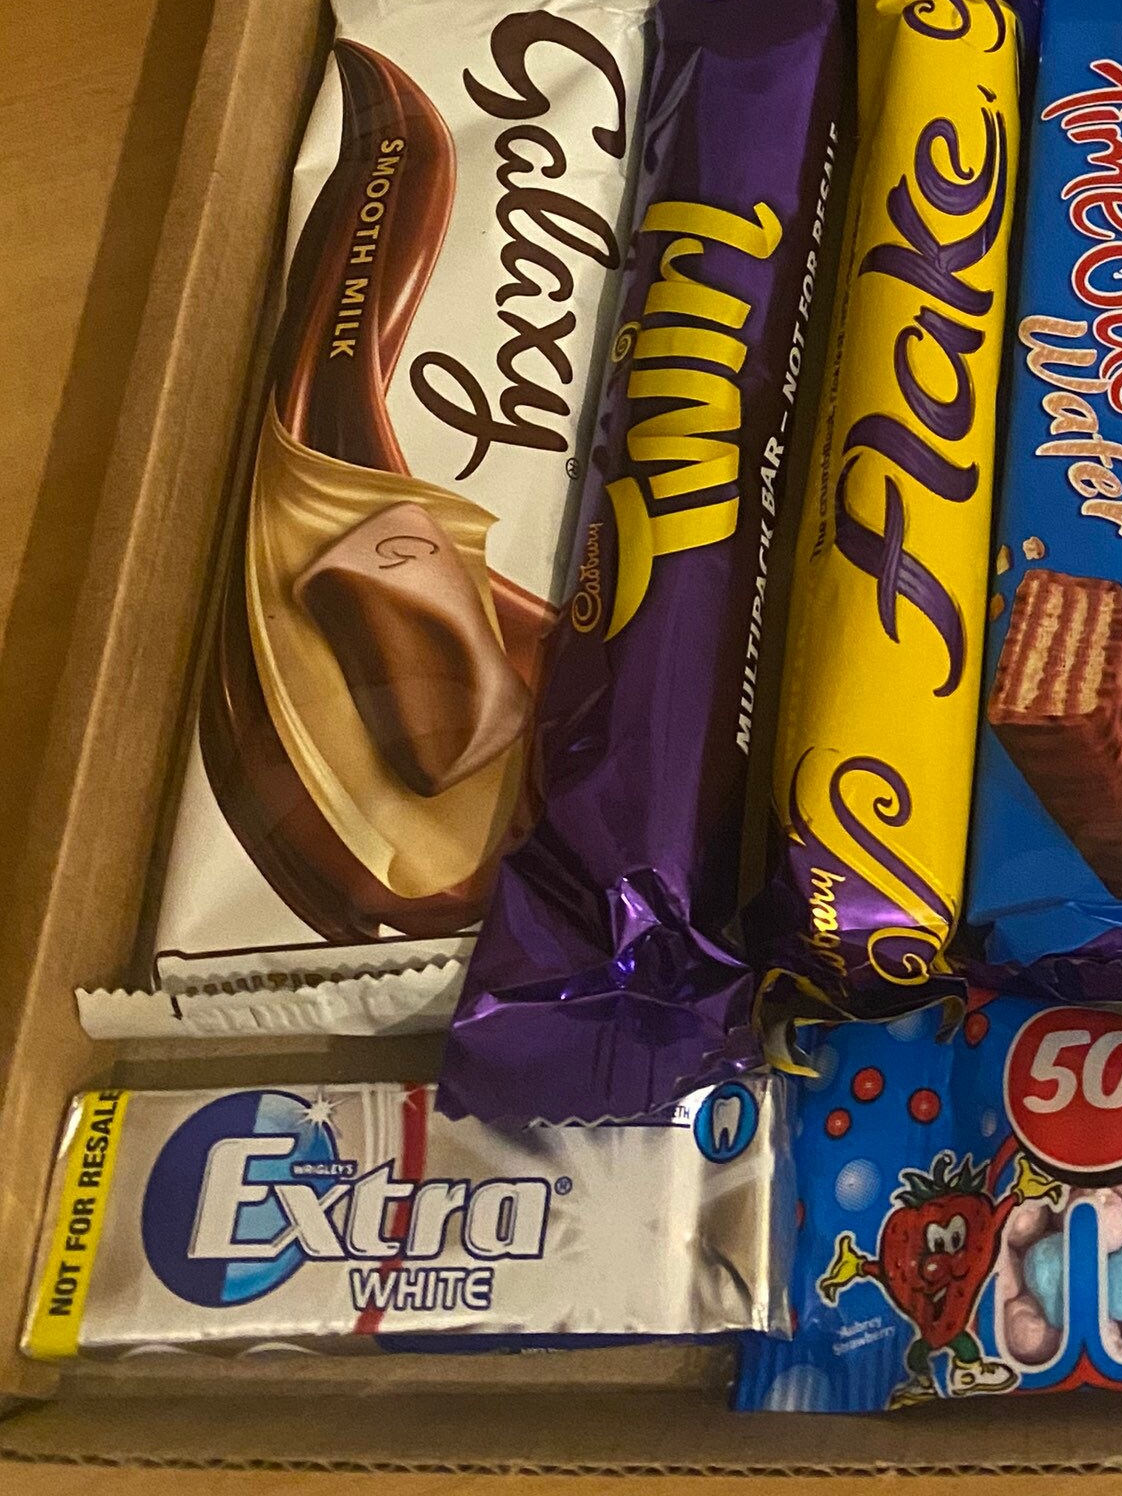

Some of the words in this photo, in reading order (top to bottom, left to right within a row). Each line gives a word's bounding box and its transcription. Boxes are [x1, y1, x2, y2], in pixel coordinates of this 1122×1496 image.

[351, 136, 406, 266] SMOOTH
[409, 9, 627, 481] Galaxy
[330, 278, 376, 361] MILK
[604, 201, 783, 643] Twirl
[739, 521, 777, 756] MULTIPACK
[761, 436, 785, 517] BAR
[783, 331, 806, 406] NOT
[799, 249, 821, 321] FOR
[572, 523, 604, 634] Cadbury
[77, 1088, 124, 1189] RESALE
[65, 1191, 97, 1249] FOR
[187, 1133, 552, 1262] Extra
[48, 1254, 82, 1317] NOT
[350, 1267, 495, 1313] WHITE
